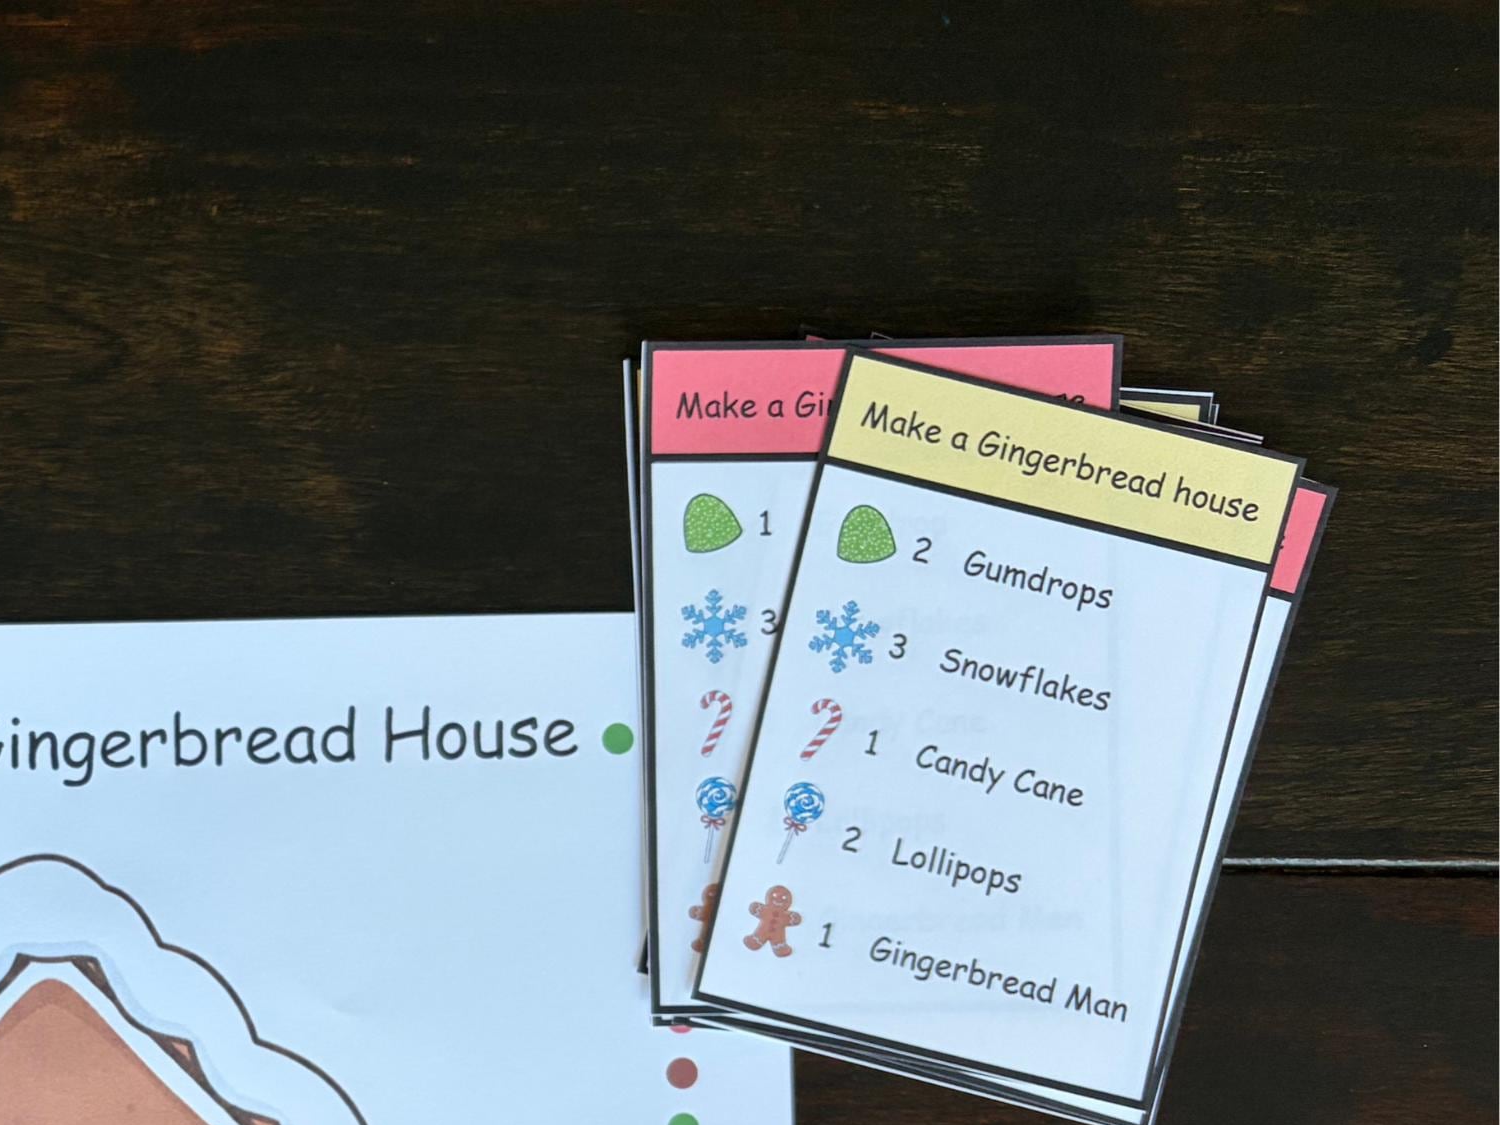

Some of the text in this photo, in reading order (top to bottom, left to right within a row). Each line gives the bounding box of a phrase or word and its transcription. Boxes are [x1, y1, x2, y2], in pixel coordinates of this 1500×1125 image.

[676, 391, 757, 419] Make
[768, 400, 784, 417] a
[861, 402, 1259, 521] Make a Gingerbread house
[760, 510, 772, 536] 1
[913, 537, 1113, 611] 2 Gumdrops
[760, 609, 779, 634] 3
[889, 634, 1111, 710] 3 Snowflakes
[385, 706, 578, 763] House
[865, 730, 1083, 806] 1 Candy Cane
[842, 826, 1021, 896] 2 Lollipops
[819, 923, 1127, 1022] 1 Gingerbread Man
